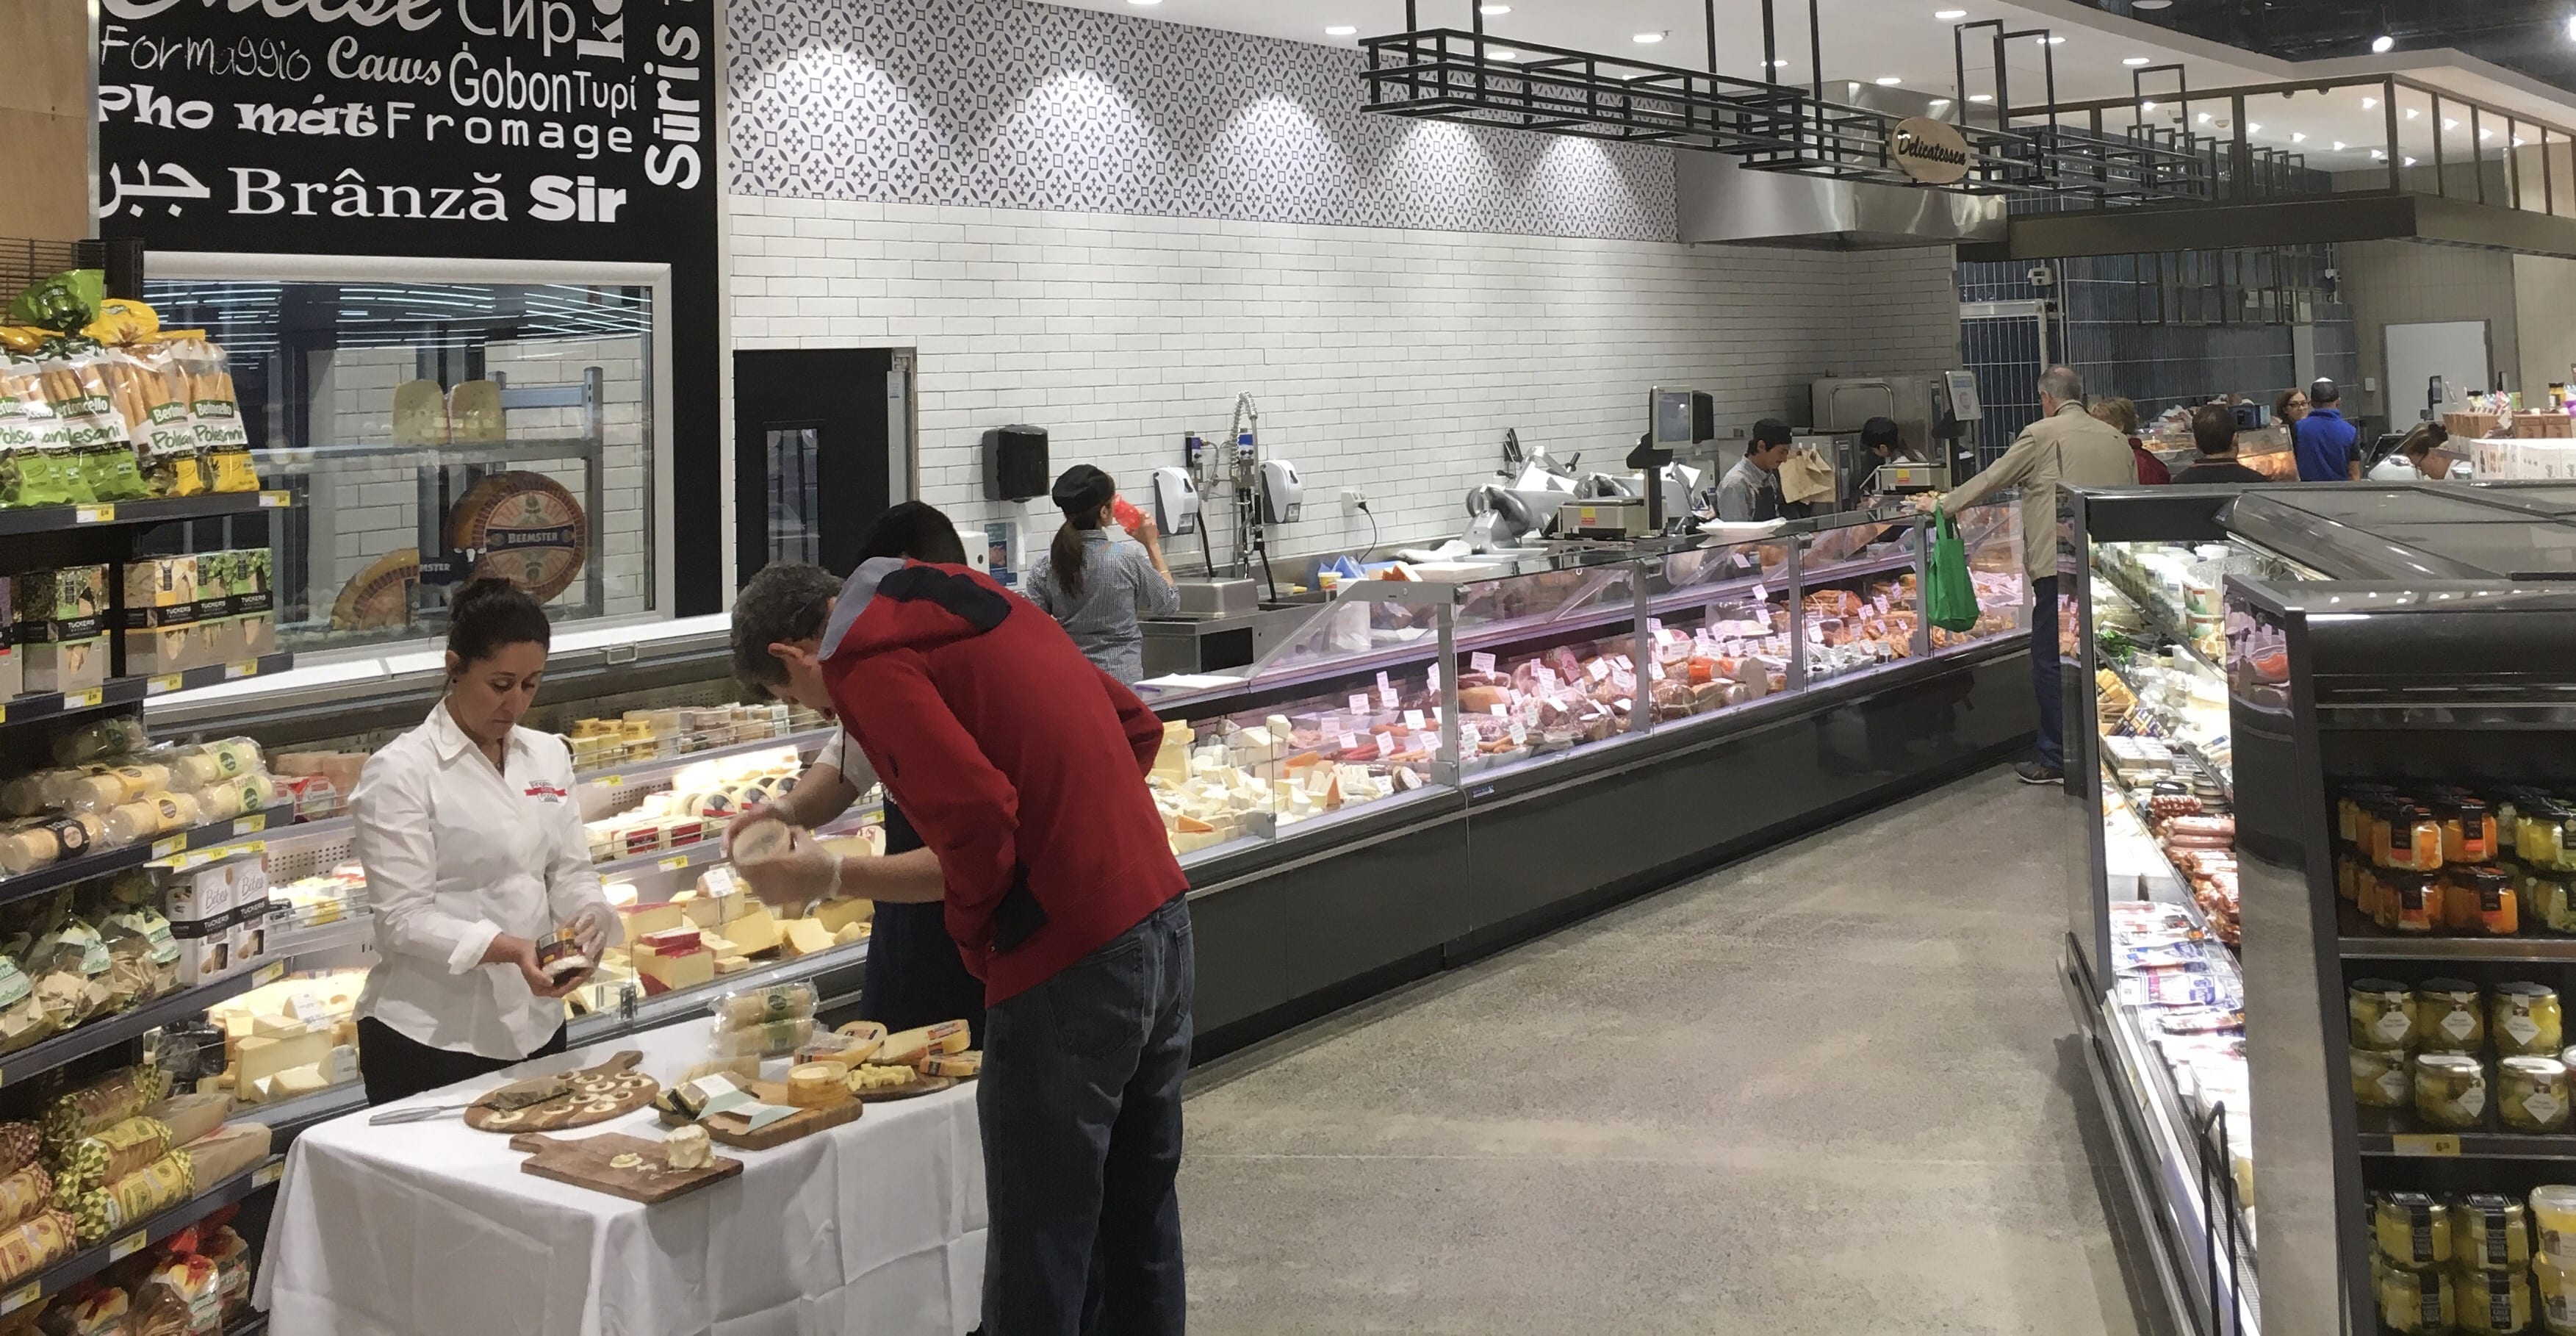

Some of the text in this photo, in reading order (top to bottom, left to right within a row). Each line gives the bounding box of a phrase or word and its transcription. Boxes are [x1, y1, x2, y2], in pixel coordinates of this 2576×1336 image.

[101, 25, 312, 82] Formaggio
[328, 36, 442, 86] Caws
[450, 42, 572, 113] Ġobon
[98, 83, 378, 137] Pho mát
[573, 71, 638, 118] Tupí
[387, 101, 633, 159] Fromage
[1898, 130, 1967, 166] Delicatessen
[228, 168, 508, 222] Brânză
[528, 175, 627, 223] Sir
[508, 532, 558, 544] BEEMSTER
[420, 563, 451, 572] MSTER
